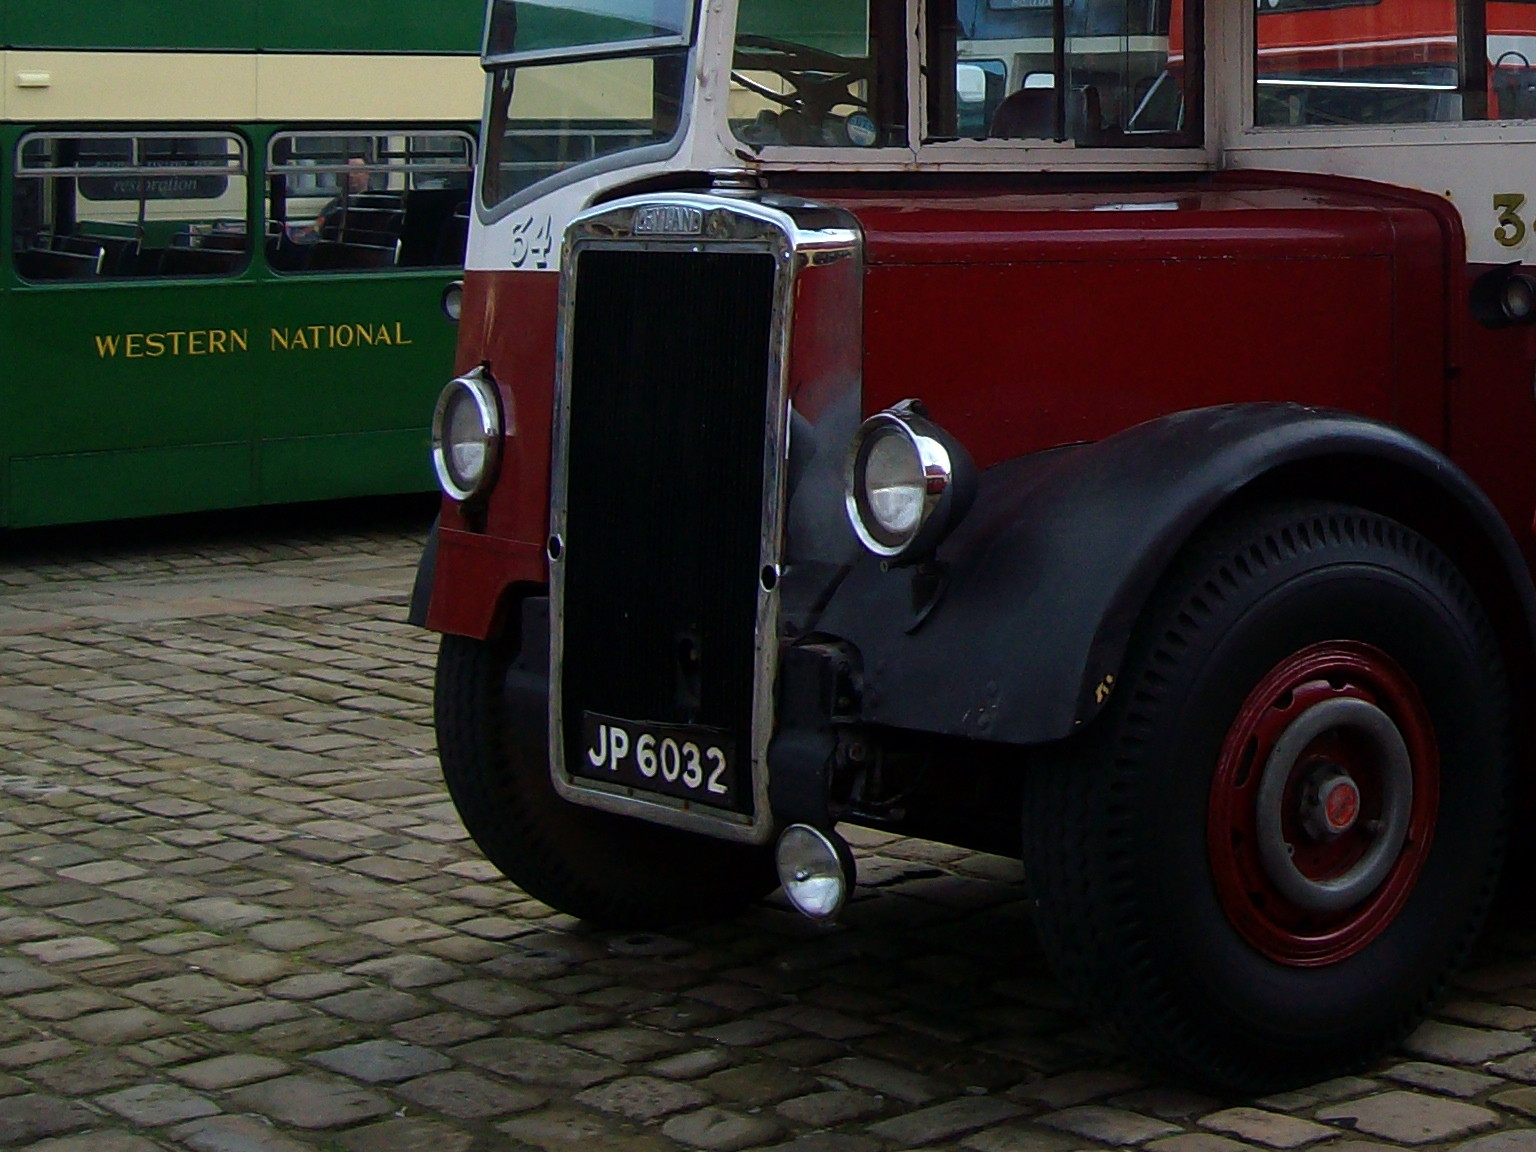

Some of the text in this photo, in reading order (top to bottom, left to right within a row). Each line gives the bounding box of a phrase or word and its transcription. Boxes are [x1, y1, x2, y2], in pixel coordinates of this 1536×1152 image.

[95, 321, 413, 359] WESTERN NATIONAL
[588, 724, 728, 794] JP 6032
